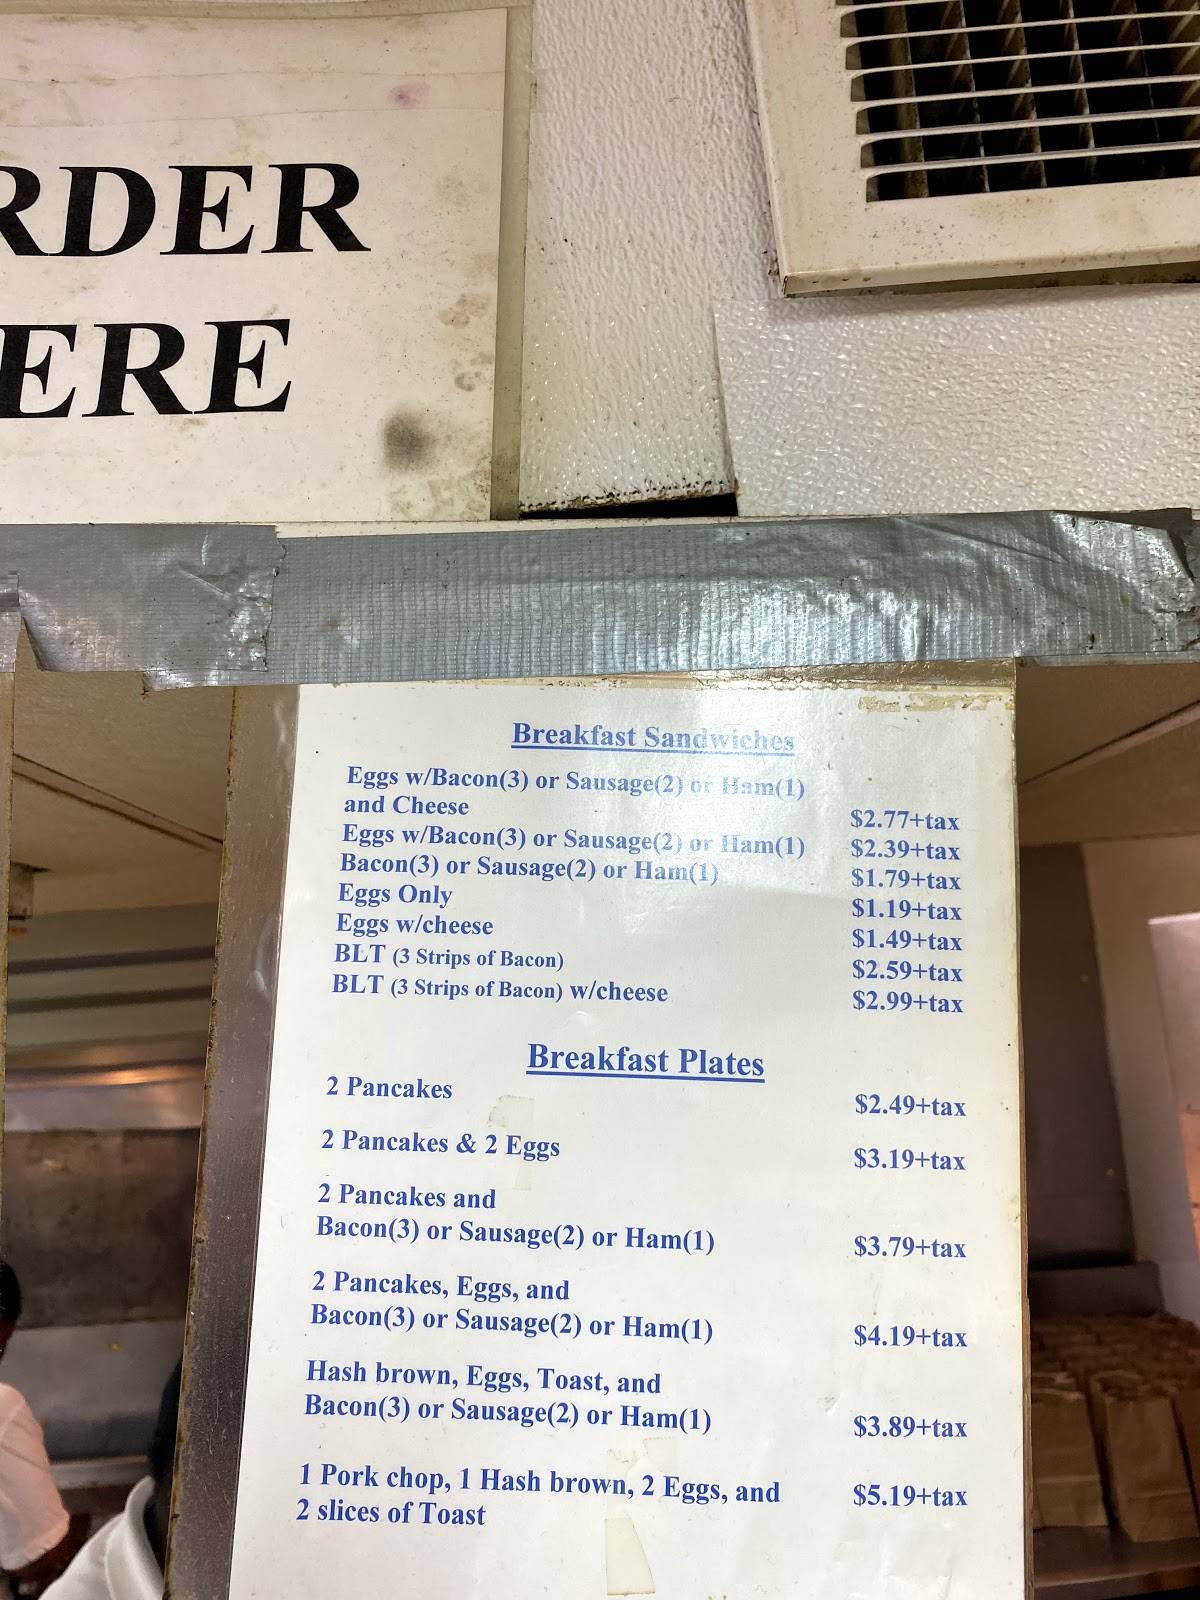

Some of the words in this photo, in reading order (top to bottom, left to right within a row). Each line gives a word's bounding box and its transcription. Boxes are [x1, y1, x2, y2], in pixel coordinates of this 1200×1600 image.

[511, 722, 637, 750] Breakfast
[644, 726, 795, 757] Sandwiches
[347, 766, 400, 790] Eggs
[405, 768, 530, 792] w/Bacon(3)
[536, 775, 559, 790] or
[564, 771, 683, 797] Sausage(2)
[691, 781, 712, 793] or
[722, 777, 807, 801] Ham(1)
[344, 795, 385, 814] and
[391, 794, 470, 816] Cheese
[849, 807, 960, 831] $2.77+tax
[343, 824, 394, 848] Eggs
[401, 824, 527, 849] w/Bacon(3)
[532, 832, 557, 848] or
[561, 826, 682, 855] Sausage(2)
[690, 838, 712, 851] or
[720, 834, 808, 863] Ham(1)
[850, 838, 960, 861] $2.39+tax
[340, 853, 440, 880] Bacon(3)
[445, 859, 471, 880] or
[476, 856, 597, 881] Sausage(2)
[601, 863, 628, 879] or
[633, 857, 720, 885] Ham(1)
[851, 866, 960, 891] $1.79+tax
[338, 883, 395, 908] Eggs
[396, 883, 450, 910] Only
[852, 897, 960, 922] $1.19+tax
[336, 913, 390, 938] Eggs
[394, 915, 493, 938] w/cheese
[851, 928, 961, 952] $1.49+tax
[335, 944, 387, 963] BLT
[393, 948, 410, 968] (3
[416, 948, 471, 970] Strips
[475, 950, 496, 968] of
[499, 950, 565, 970] Bacon)
[850, 959, 961, 983] $2.59+tax
[332, 974, 384, 994] BLT
[388, 977, 408, 997] (3
[414, 979, 472, 1000] Strips
[475, 978, 498, 997] of
[498, 981, 564, 1002] Bacon)
[569, 980, 668, 1003] w/cheese
[851, 989, 962, 1014] $2.99+tax
[526, 1043, 669, 1076] Breakfast
[677, 1048, 765, 1083] Plates
[326, 1076, 338, 1096] 2
[347, 1076, 454, 1099] Pancakes
[855, 1093, 965, 1117] $2.49+tax
[322, 1129, 333, 1149] 2
[341, 1130, 448, 1152] Pancakes
[456, 1132, 477, 1153] &
[485, 1134, 497, 1154] 2
[505, 1135, 560, 1162] Eggs
[854, 1147, 964, 1170] $3.19+tax
[319, 1183, 330, 1203] 2
[339, 1184, 445, 1208] Pancakes
[453, 1189, 496, 1209] and
[315, 1216, 420, 1243] Bacon(3)
[427, 1224, 452, 1240] or
[459, 1220, 584, 1249] Sausage(2)
[592, 1231, 618, 1248] or
[626, 1227, 714, 1255] Ham(1)
[854, 1235, 966, 1258] $3.79+tax
[312, 1270, 325, 1291] 2
[332, 1271, 448, 1297] Pancakes,
[456, 1276, 522, 1303] Eggs,
[526, 1280, 570, 1301] and
[310, 1304, 415, 1332] Bacon(3)
[420, 1312, 448, 1328] or
[456, 1308, 581, 1338] Sausage(2)
[590, 1320, 615, 1336] or
[622, 1315, 713, 1344] Ham(1)
[854, 1324, 968, 1348] $4.19+tax
[306, 1360, 367, 1383] Hash
[375, 1362, 458, 1389] brown,
[465, 1365, 529, 1394] Eggs,
[537, 1368, 609, 1395] Toast,
[616, 1373, 661, 1394] and
[305, 1392, 412, 1422] Bacon(3)
[416, 1402, 444, 1420] or
[451, 1397, 580, 1429] Sausage(2)
[587, 1409, 613, 1425] or
[620, 1404, 711, 1435] Ham(1)
[854, 1415, 967, 1438] $3.89+tax
[302, 1463, 311, 1487] 1
[321, 1464, 381, 1488] Pork
[386, 1465, 451, 1495] chop,
[460, 1468, 471, 1489] 1
[480, 1468, 541, 1492] Hash
[550, 1471, 634, 1499] brown,
[642, 1474, 654, 1496] 2
[663, 1475, 728, 1505] Eggs,
[736, 1481, 780, 1504] and
[854, 1483, 968, 1507] $5.19+tax
[296, 1496, 311, 1520] 2
[316, 1497, 381, 1523] slices
[387, 1501, 414, 1524] of
[419, 1502, 486, 1526] Toast
